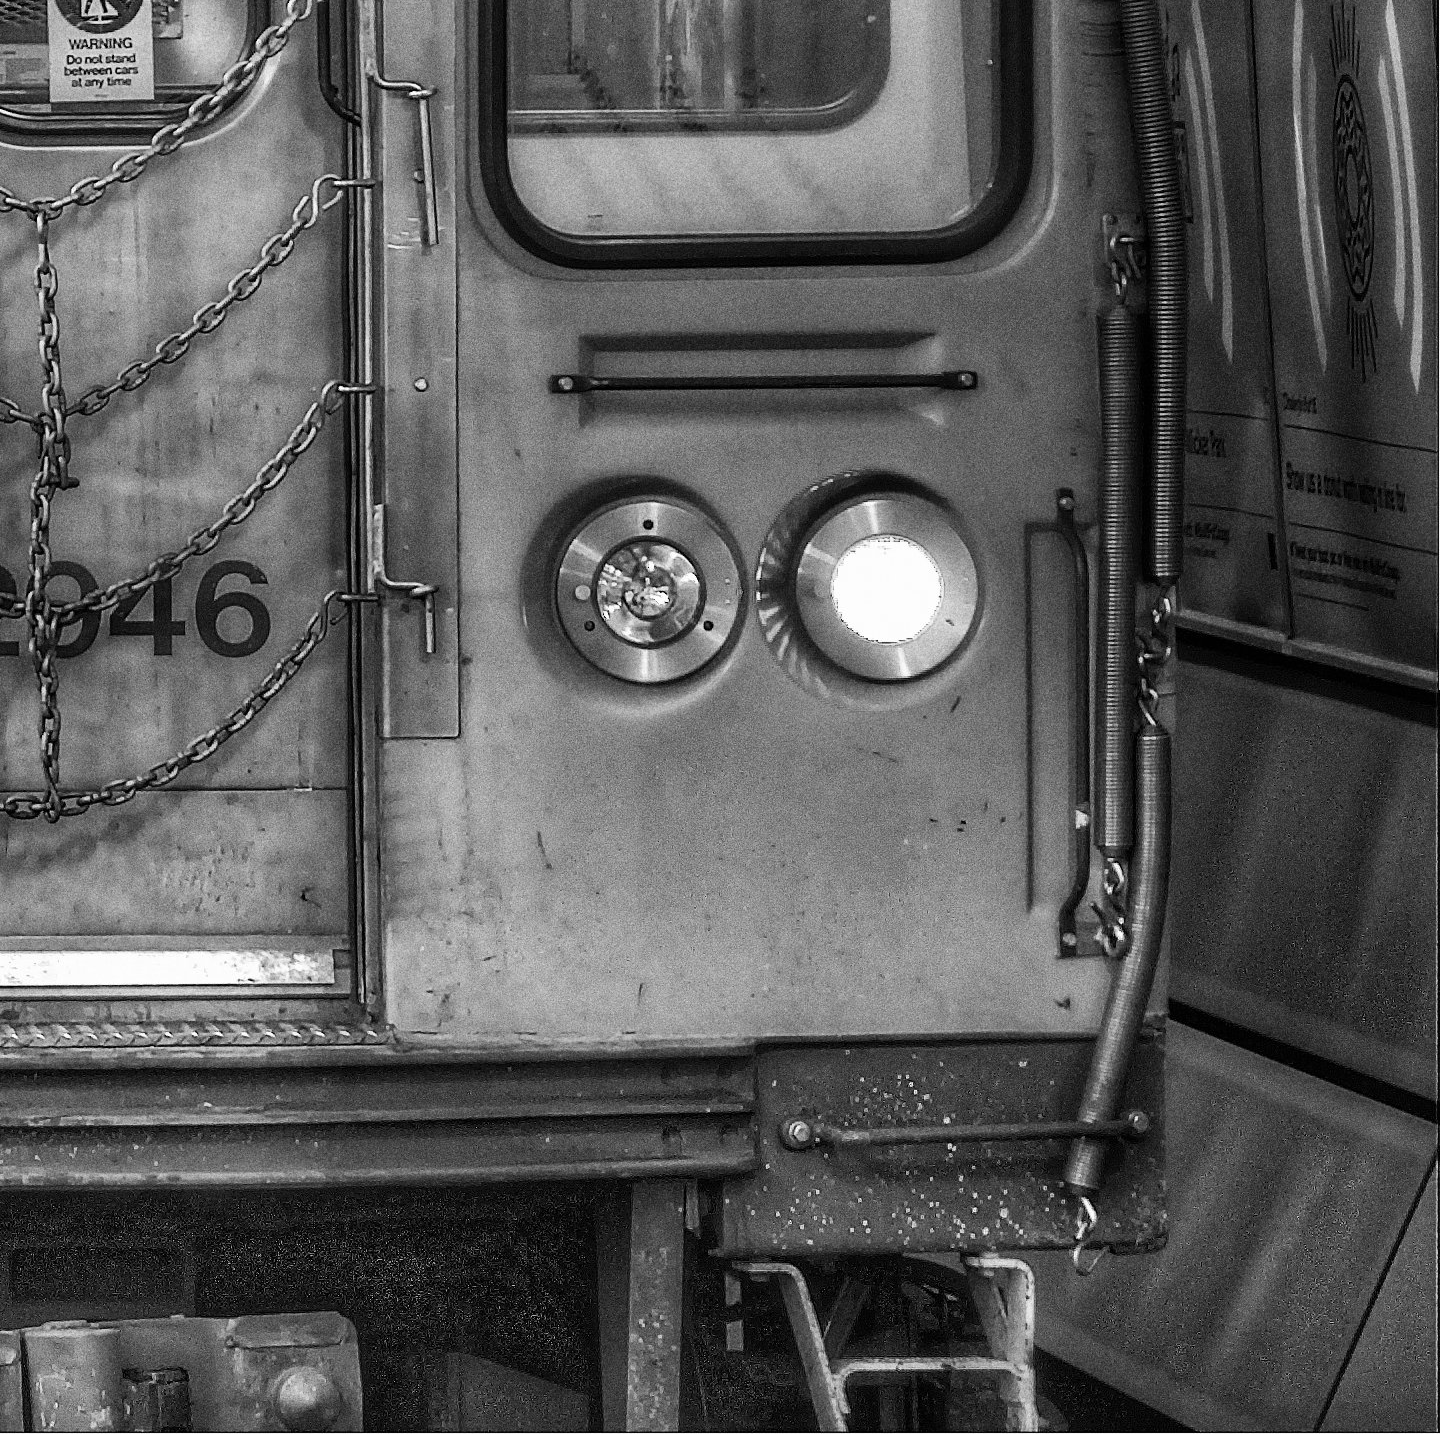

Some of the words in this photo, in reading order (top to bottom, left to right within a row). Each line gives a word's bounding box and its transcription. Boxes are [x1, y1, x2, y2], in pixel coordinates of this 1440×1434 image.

[68, 37, 133, 50] WARNING
[66, 55, 82, 65] Do
[84, 54, 104, 65] not
[105, 53, 136, 64] stand
[63, 65, 113, 76] between
[114, 67, 139, 76] cars
[71, 78, 83, 88] at
[84, 78, 104, 89] any
[106, 76, 132, 87] time
